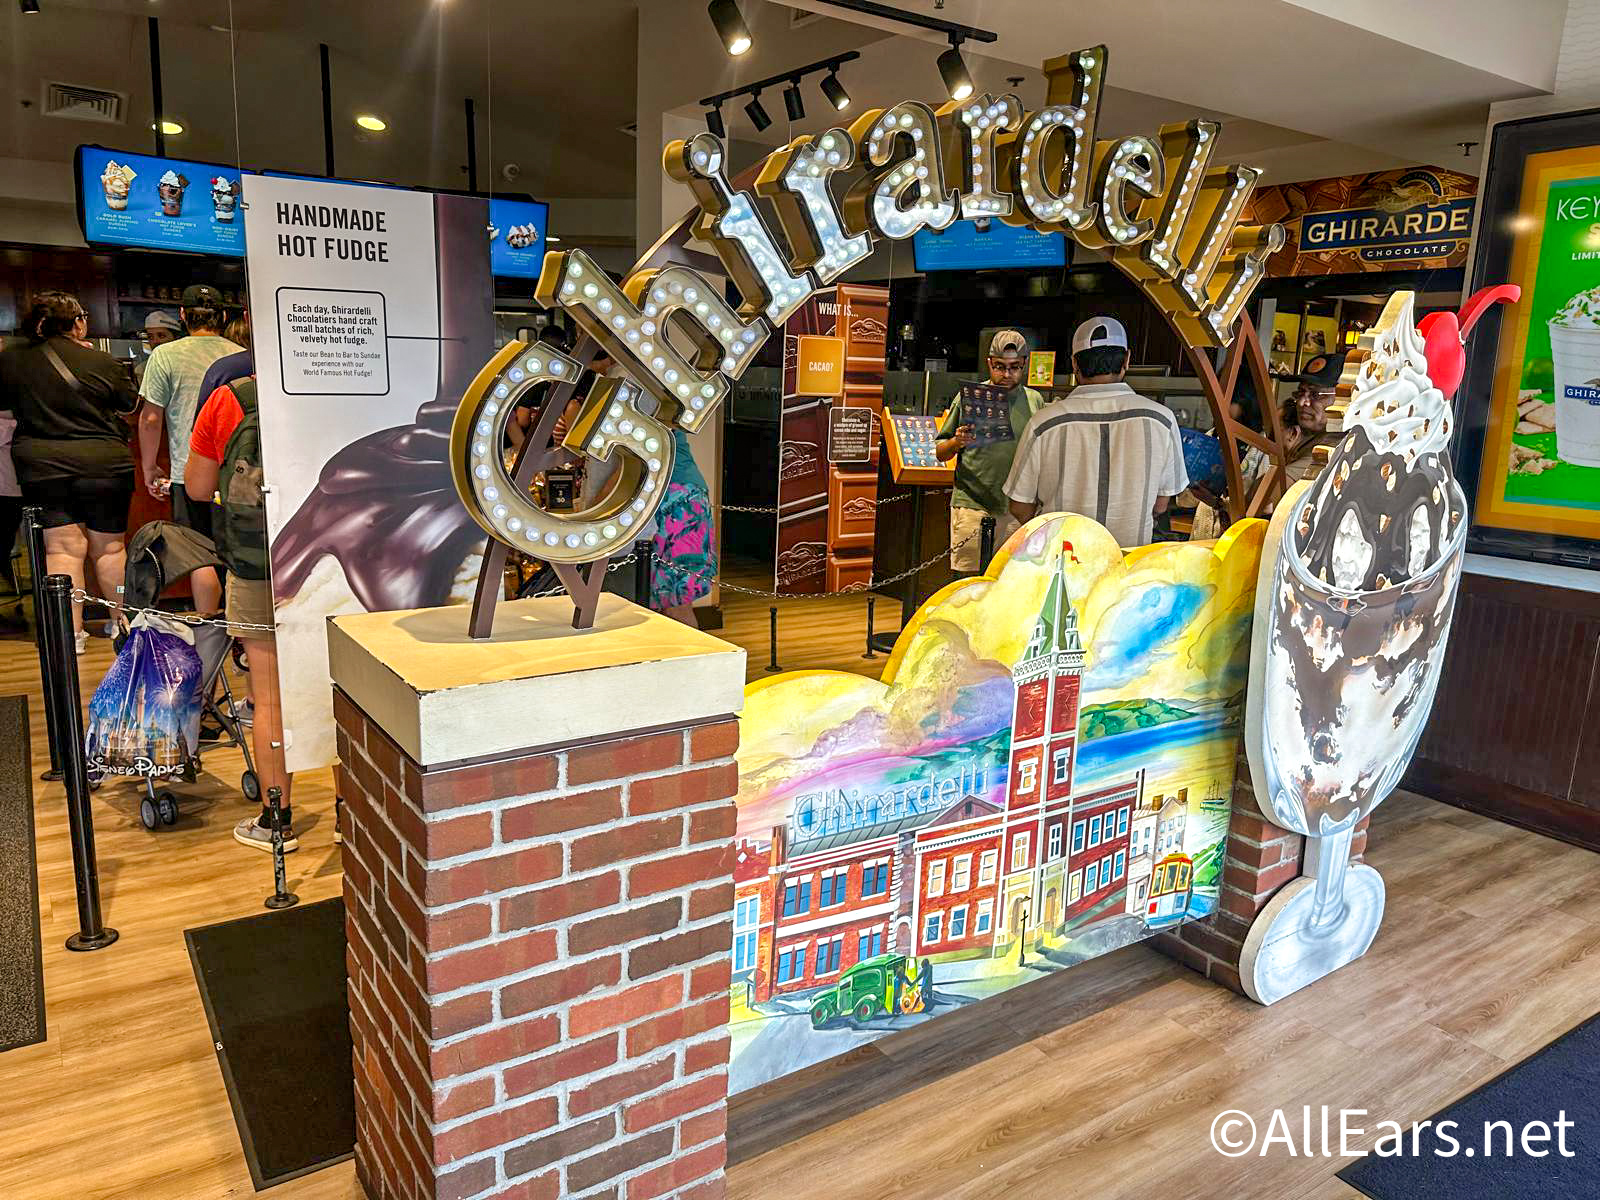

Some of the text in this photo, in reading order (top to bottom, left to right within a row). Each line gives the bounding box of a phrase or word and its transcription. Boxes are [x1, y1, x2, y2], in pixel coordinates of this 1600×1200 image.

[276, 202, 387, 232] HANDMADE
[278, 233, 389, 262] HOT FUDGE
[1367, 245, 1447, 258] CHOCOLATE
[292, 303, 371, 316] Each day, Ghirardelli
[450, 44, 1286, 563] Ghirardelli
[818, 302, 859, 318] WHAT IS...
[287, 314, 378, 326] Chocolatiers hand craft
[292, 324, 375, 336] small batches of rich,
[300, 334, 368, 346] velvety hot fudge.
[293, 350, 309, 358] Taste
[320, 350, 335, 358] Bean
[343, 351, 353, 359] Bar
[808, 361, 834, 372] CACAO?
[354, 370, 373, 378] Fudge!
[792, 754, 990, 838] Ghirardelli
